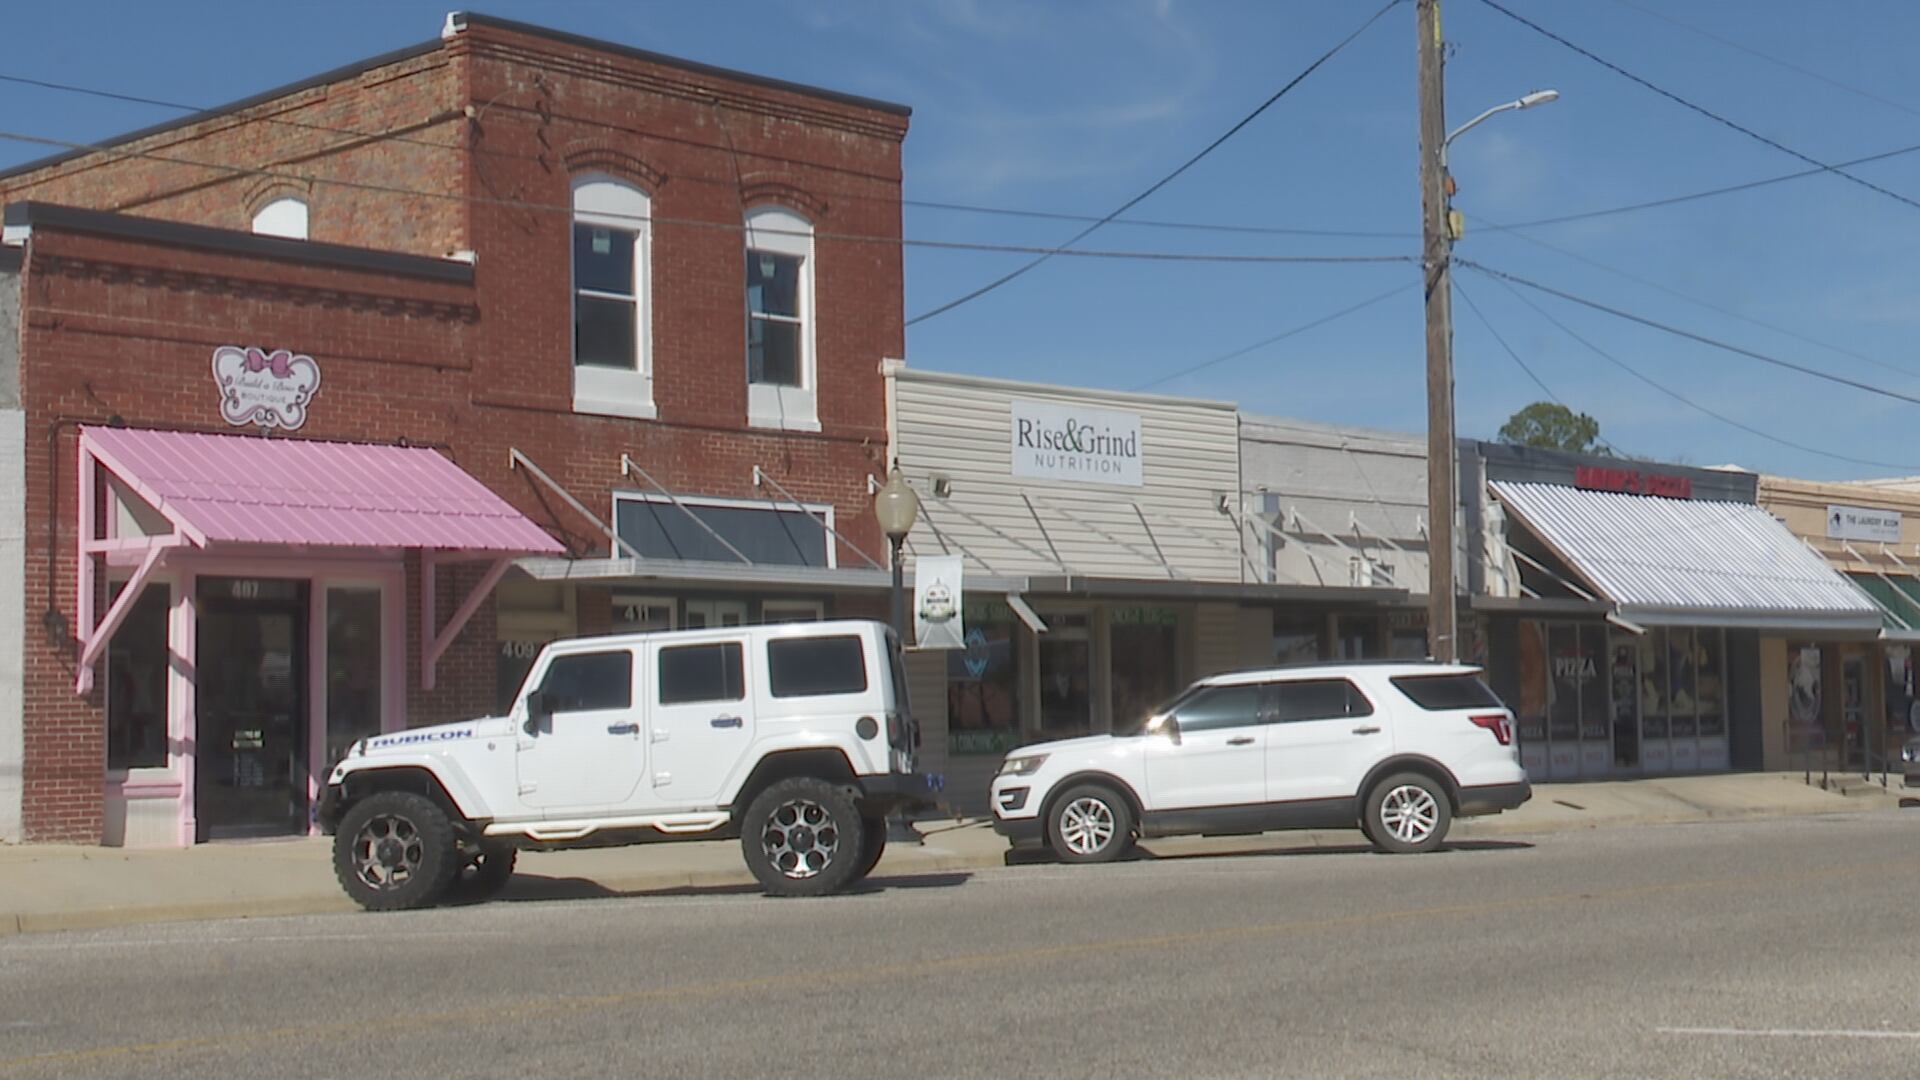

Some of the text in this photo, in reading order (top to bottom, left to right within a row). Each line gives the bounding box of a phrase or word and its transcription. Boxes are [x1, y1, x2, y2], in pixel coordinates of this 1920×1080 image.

[1035, 454, 1121, 474] NUTRITION
[1846, 514, 1856, 523] THE
[232, 580, 260, 600] 407
[624, 605, 650, 621] 411
[502, 641, 535, 660] 409
[1555, 657, 1596, 678] PIZZA
[373, 731, 472, 747] RUBICON
